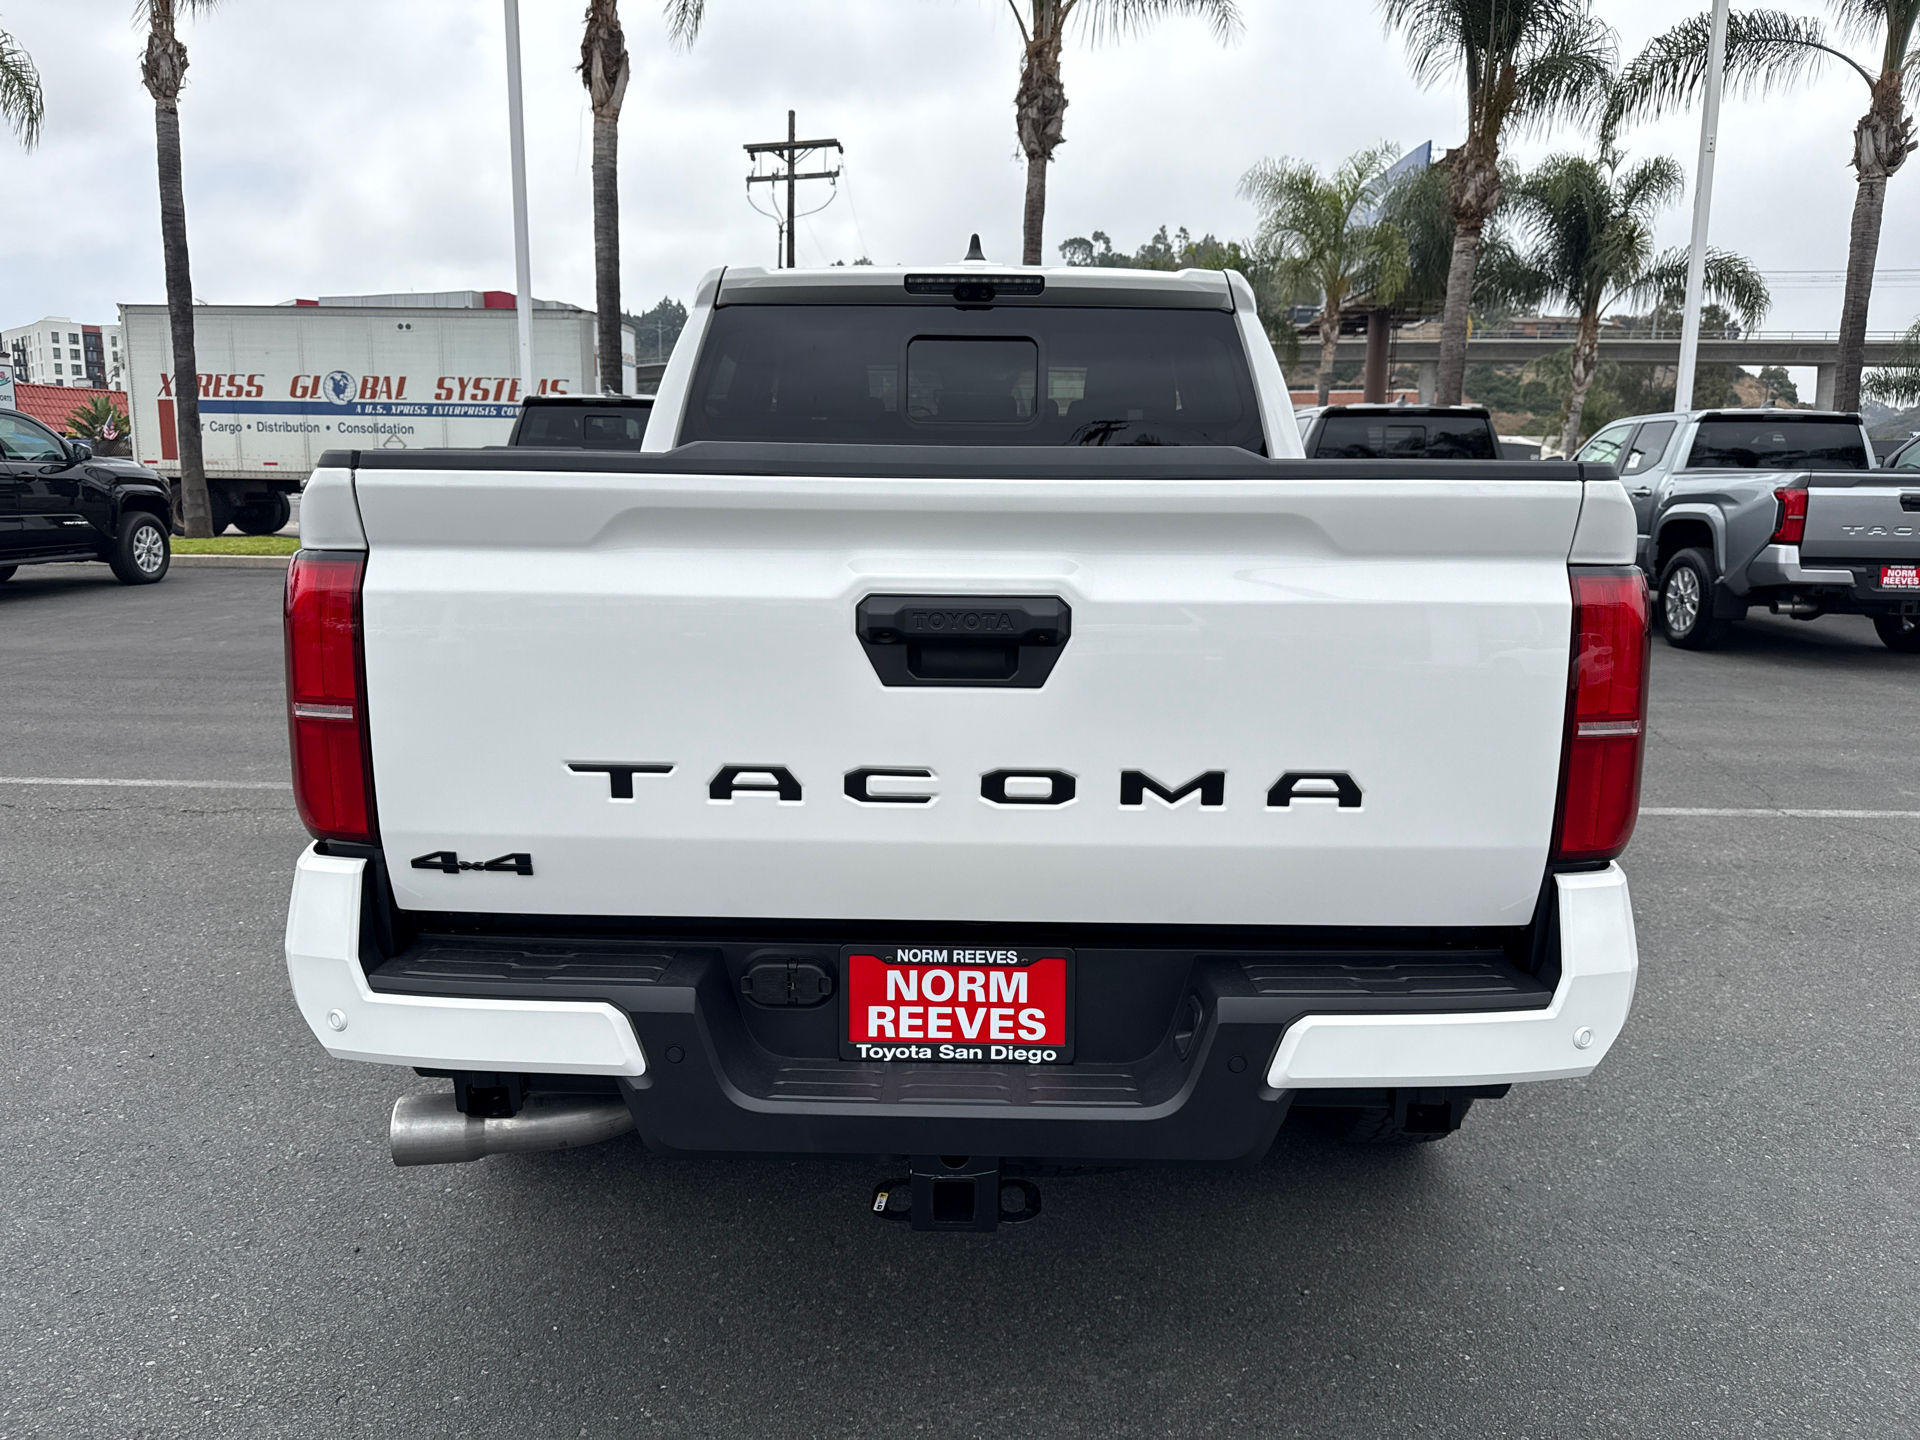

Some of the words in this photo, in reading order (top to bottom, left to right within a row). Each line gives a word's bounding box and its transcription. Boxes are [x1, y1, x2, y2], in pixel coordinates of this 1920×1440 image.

[157, 373, 265, 398] XRESS
[365, 406, 386, 414] U.S.
[390, 406, 428, 415] XPRESS
[432, 406, 497, 416] ENTERPRISES
[209, 421, 242, 434] Cargo
[256, 421, 320, 433] Distribution
[338, 422, 414, 435] Consolidation
[1842, 525, 1920, 536] TAC
[1883, 577, 1919, 585] REEVES
[913, 612, 1014, 630] TOYOTA
[567, 763, 1363, 807] TACOMA
[411, 851, 534, 876] 4x4
[897, 949, 948, 963] NORM
[953, 951, 1018, 964] REEVES
[887, 969, 1028, 1003] NORM
[868, 1006, 1047, 1041] REEVES
[856, 1044, 932, 1061] Toyota
[938, 1044, 982, 1059] San
[990, 1045, 1057, 1064] Diego
